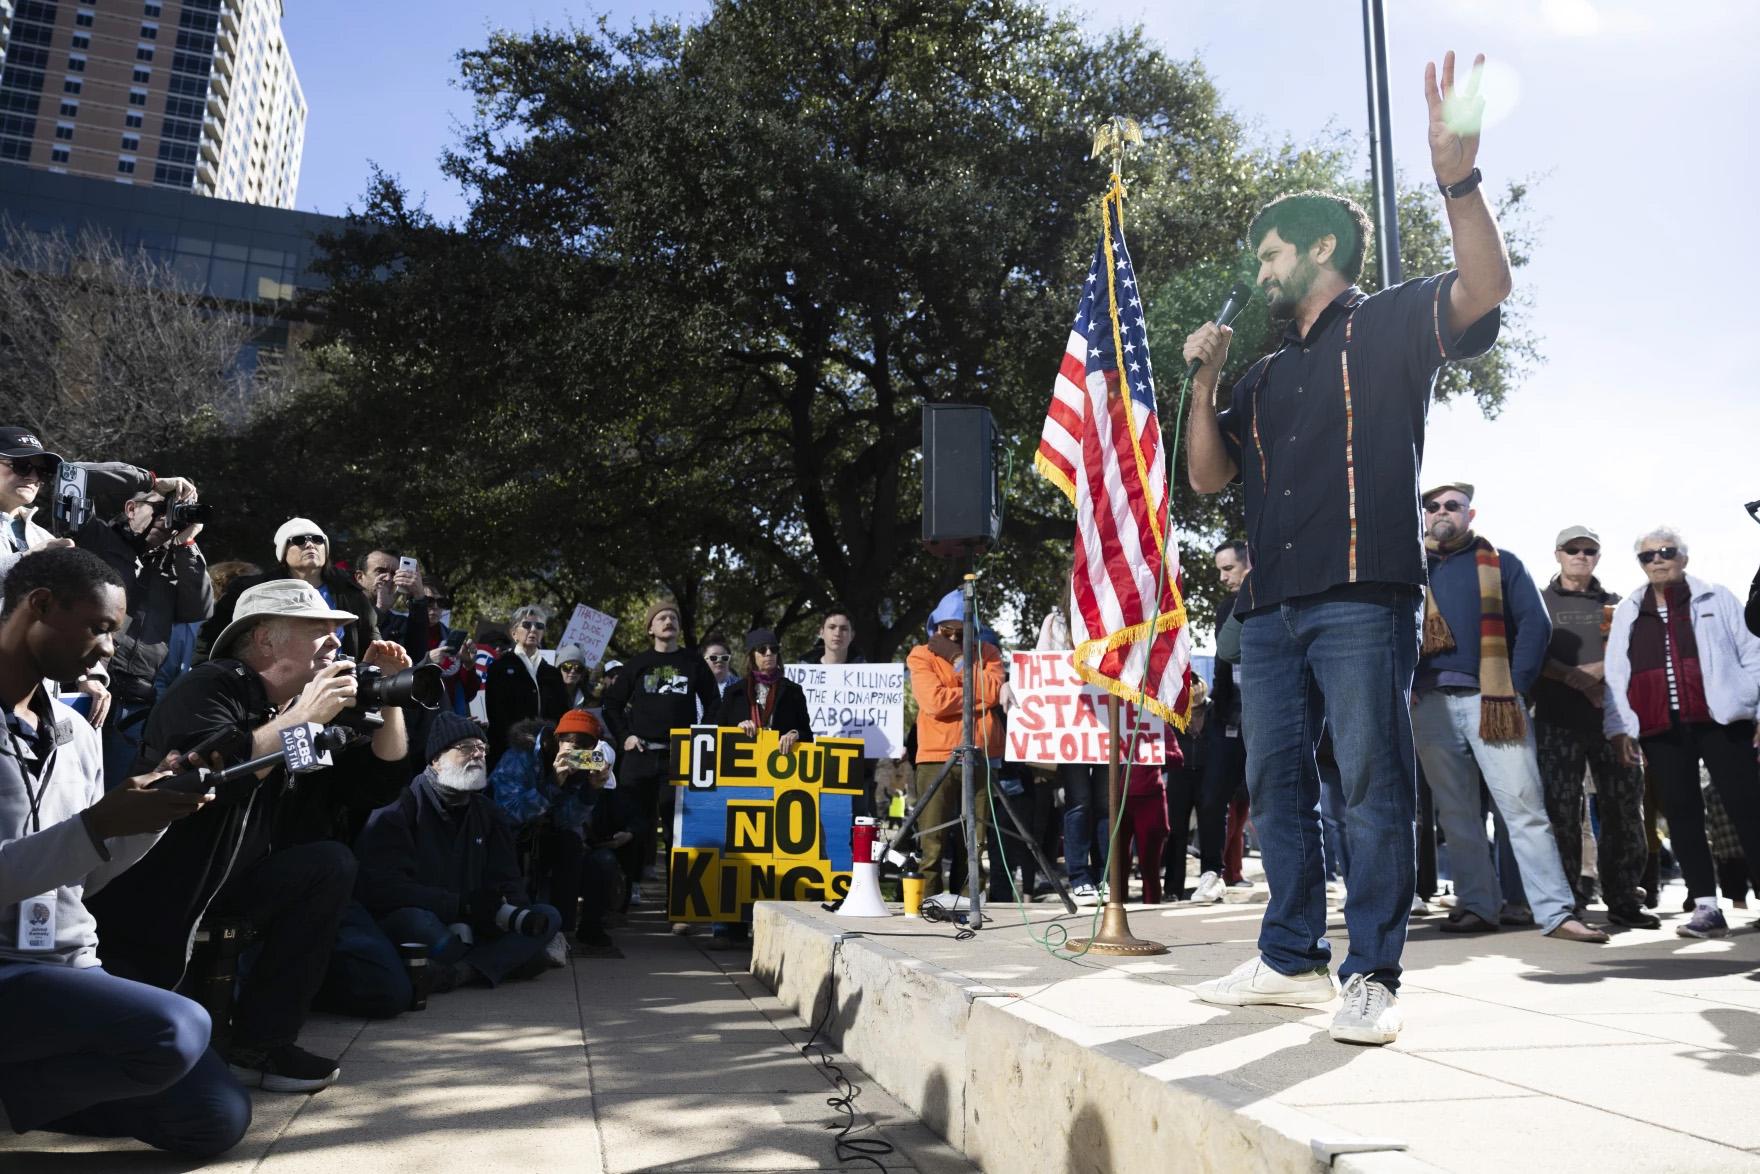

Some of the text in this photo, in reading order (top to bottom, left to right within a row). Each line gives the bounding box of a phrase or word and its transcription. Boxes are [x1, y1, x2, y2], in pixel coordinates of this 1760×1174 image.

[568, 628, 577, 640] I
[784, 667, 903, 689] ND THE KILLINGS
[806, 688, 903, 705] THE KIDNAPPINGS
[811, 706, 888, 728] ABOLISH
[282, 731, 300, 769] AUSTIN
[296, 738, 313, 766] CBS
[1009, 731, 1163, 764] VIOLENCE
[766, 748, 859, 784] OUT
[734, 789, 817, 855] NO
